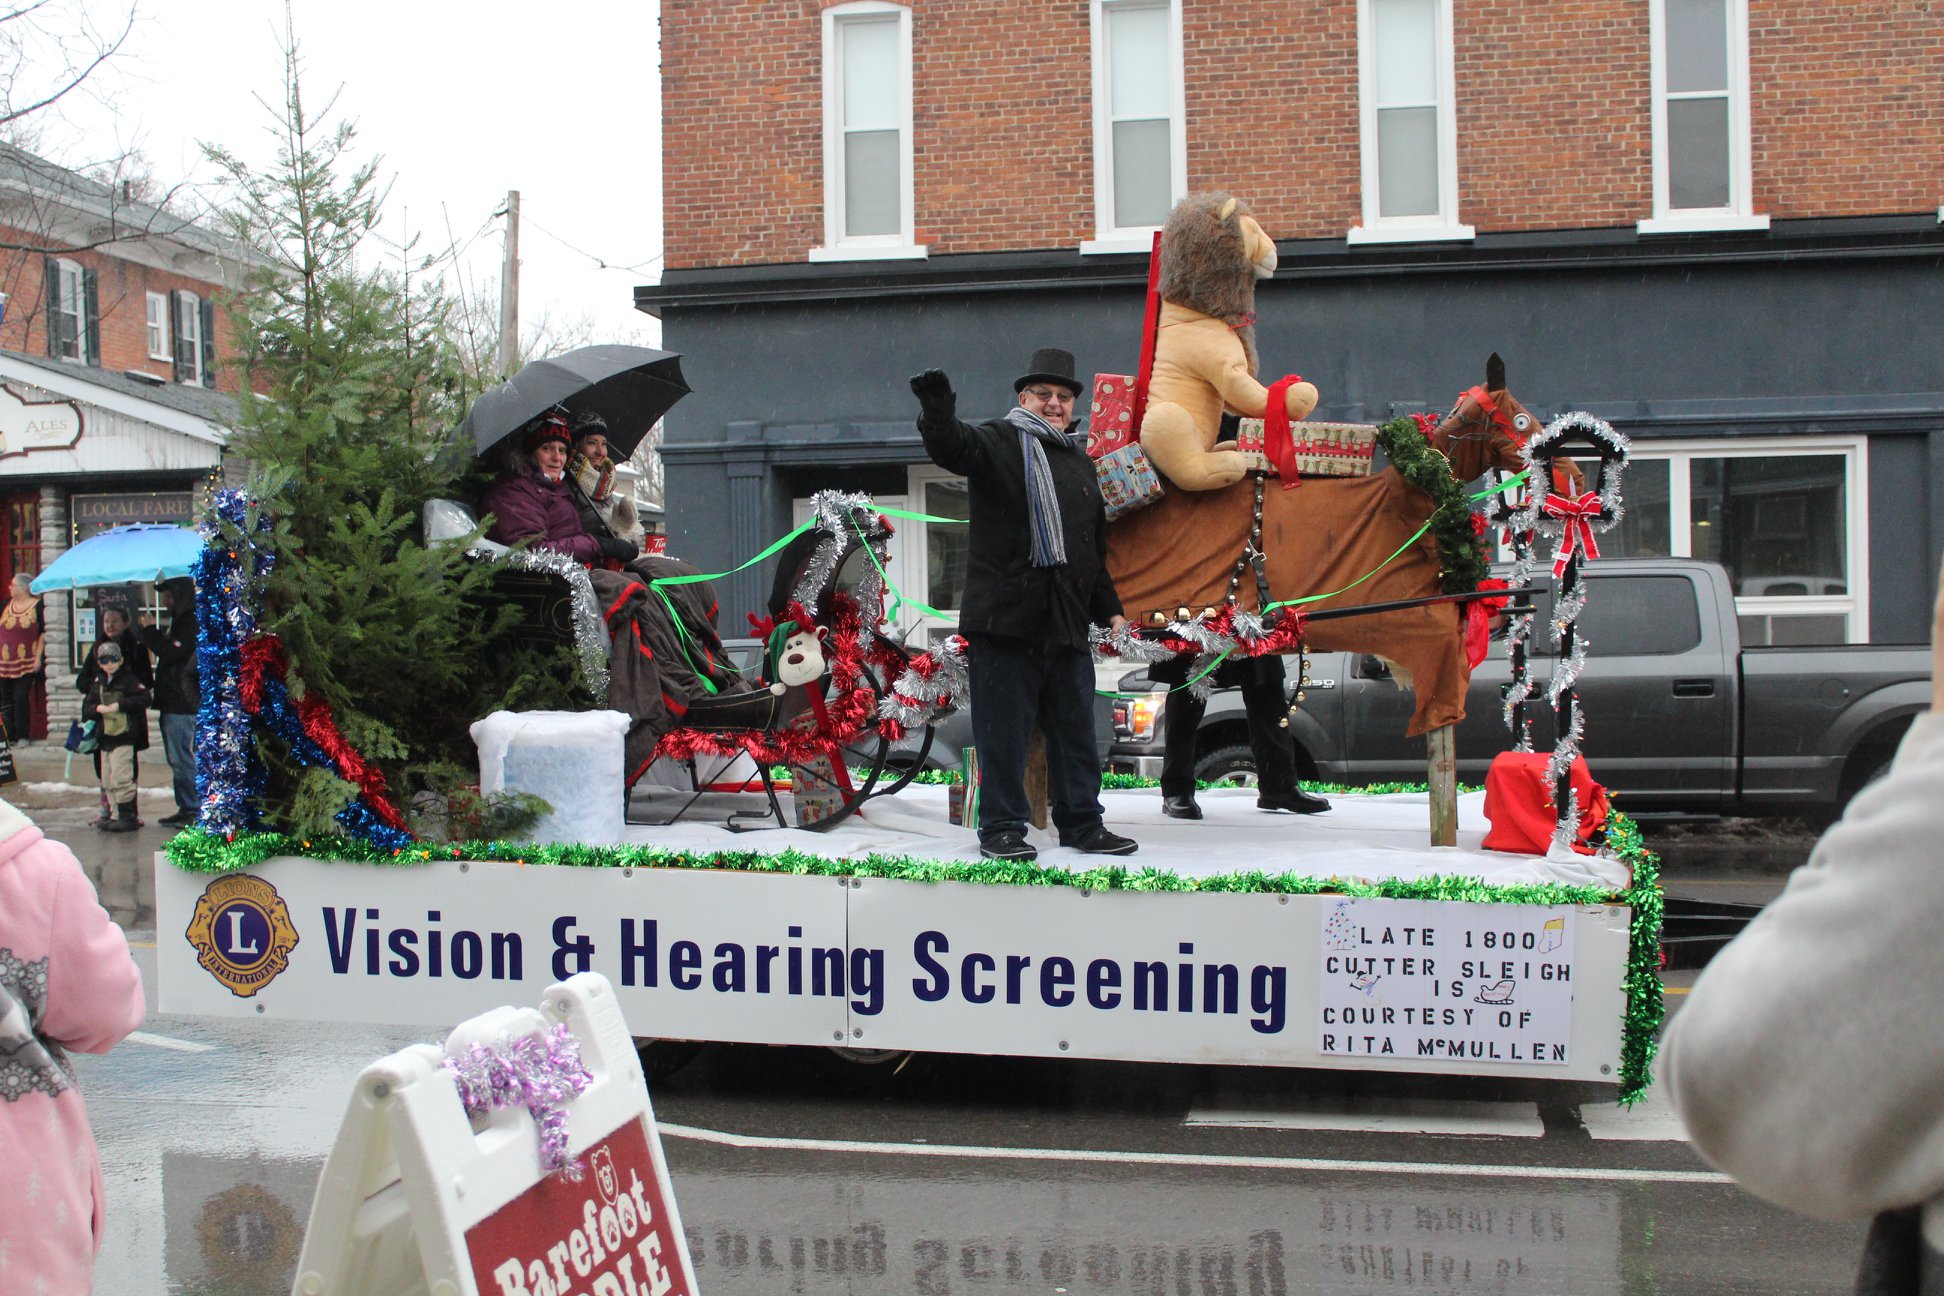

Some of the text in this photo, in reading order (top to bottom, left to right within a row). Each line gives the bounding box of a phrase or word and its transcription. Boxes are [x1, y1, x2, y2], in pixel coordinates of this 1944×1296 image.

[25, 420, 68, 433] ALES
[82, 500, 188, 517] LOCAL FARE
[210, 880, 272, 905] LIONS
[227, 911, 258, 954] L
[1361, 927, 1535, 949] LATE 1800
[208, 955, 279, 984] INTERNATIONAL
[323, 907, 1287, 1034] Vision & Hearing Screening
[1326, 956, 1570, 981] CUTTER SLEIGH
[1434, 980, 1464, 998] IS
[1323, 1007, 1532, 1028] COURTESY OF
[1323, 1034, 1565, 1061] RITA McMULLEN
[493, 1168, 652, 1296] Barefoot
